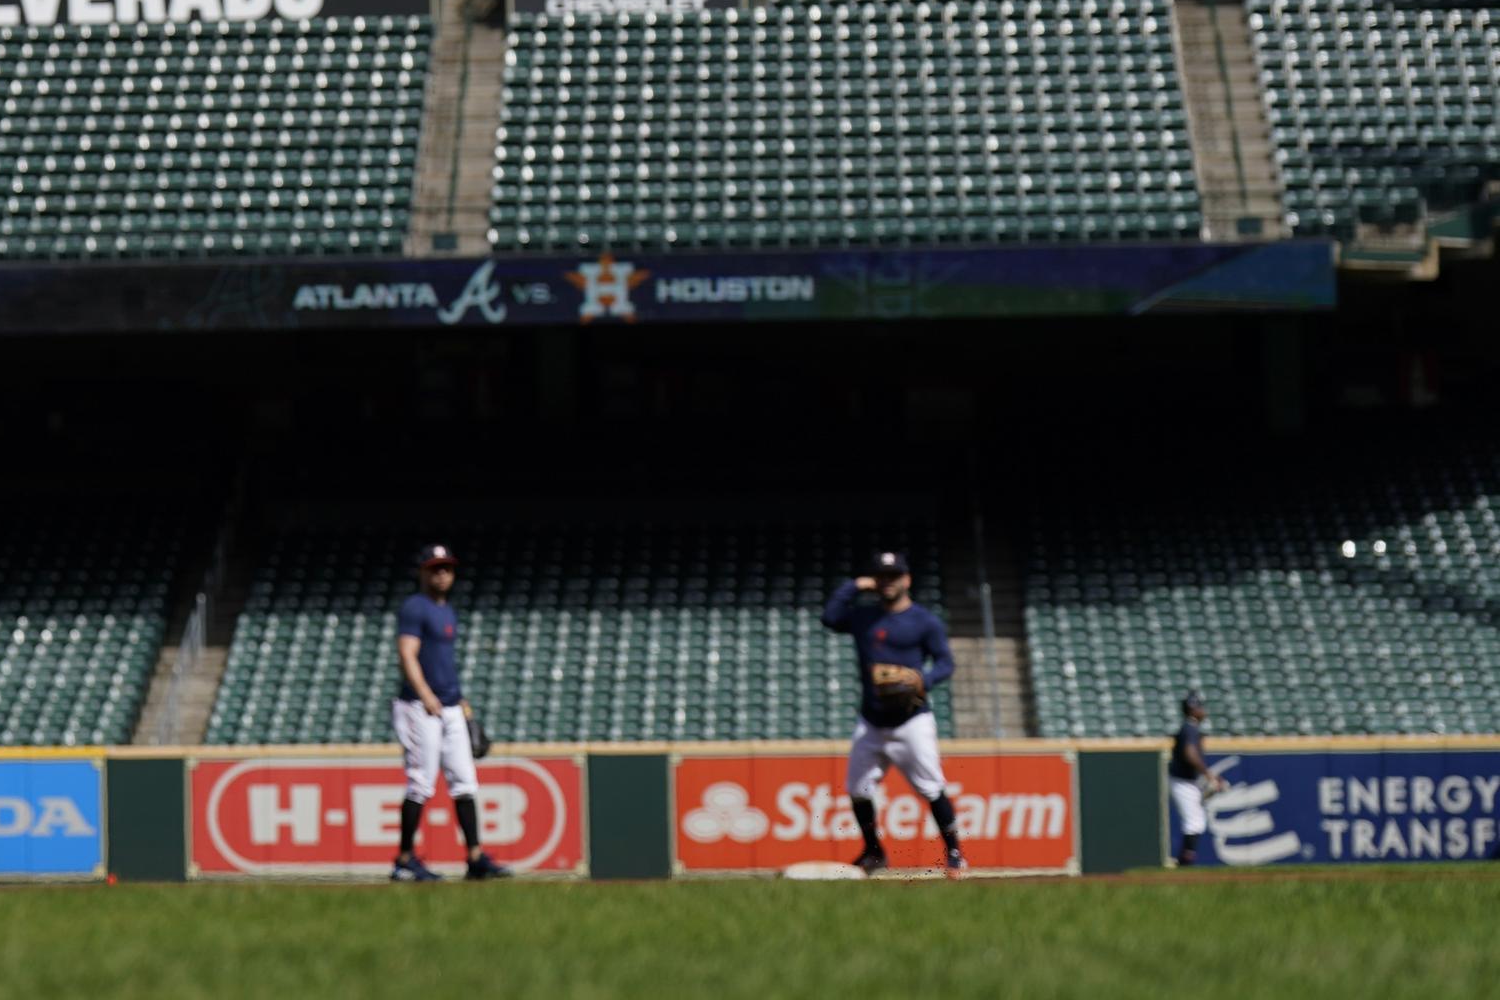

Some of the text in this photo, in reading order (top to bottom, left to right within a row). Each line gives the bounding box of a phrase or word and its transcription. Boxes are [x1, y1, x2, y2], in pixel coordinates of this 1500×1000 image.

[293, 282, 439, 311] ATLANTA
[656, 276, 814, 303] HOUSTON
[1317, 774, 1500, 814] ENERGY
[247, 784, 528, 846] H-E-B
